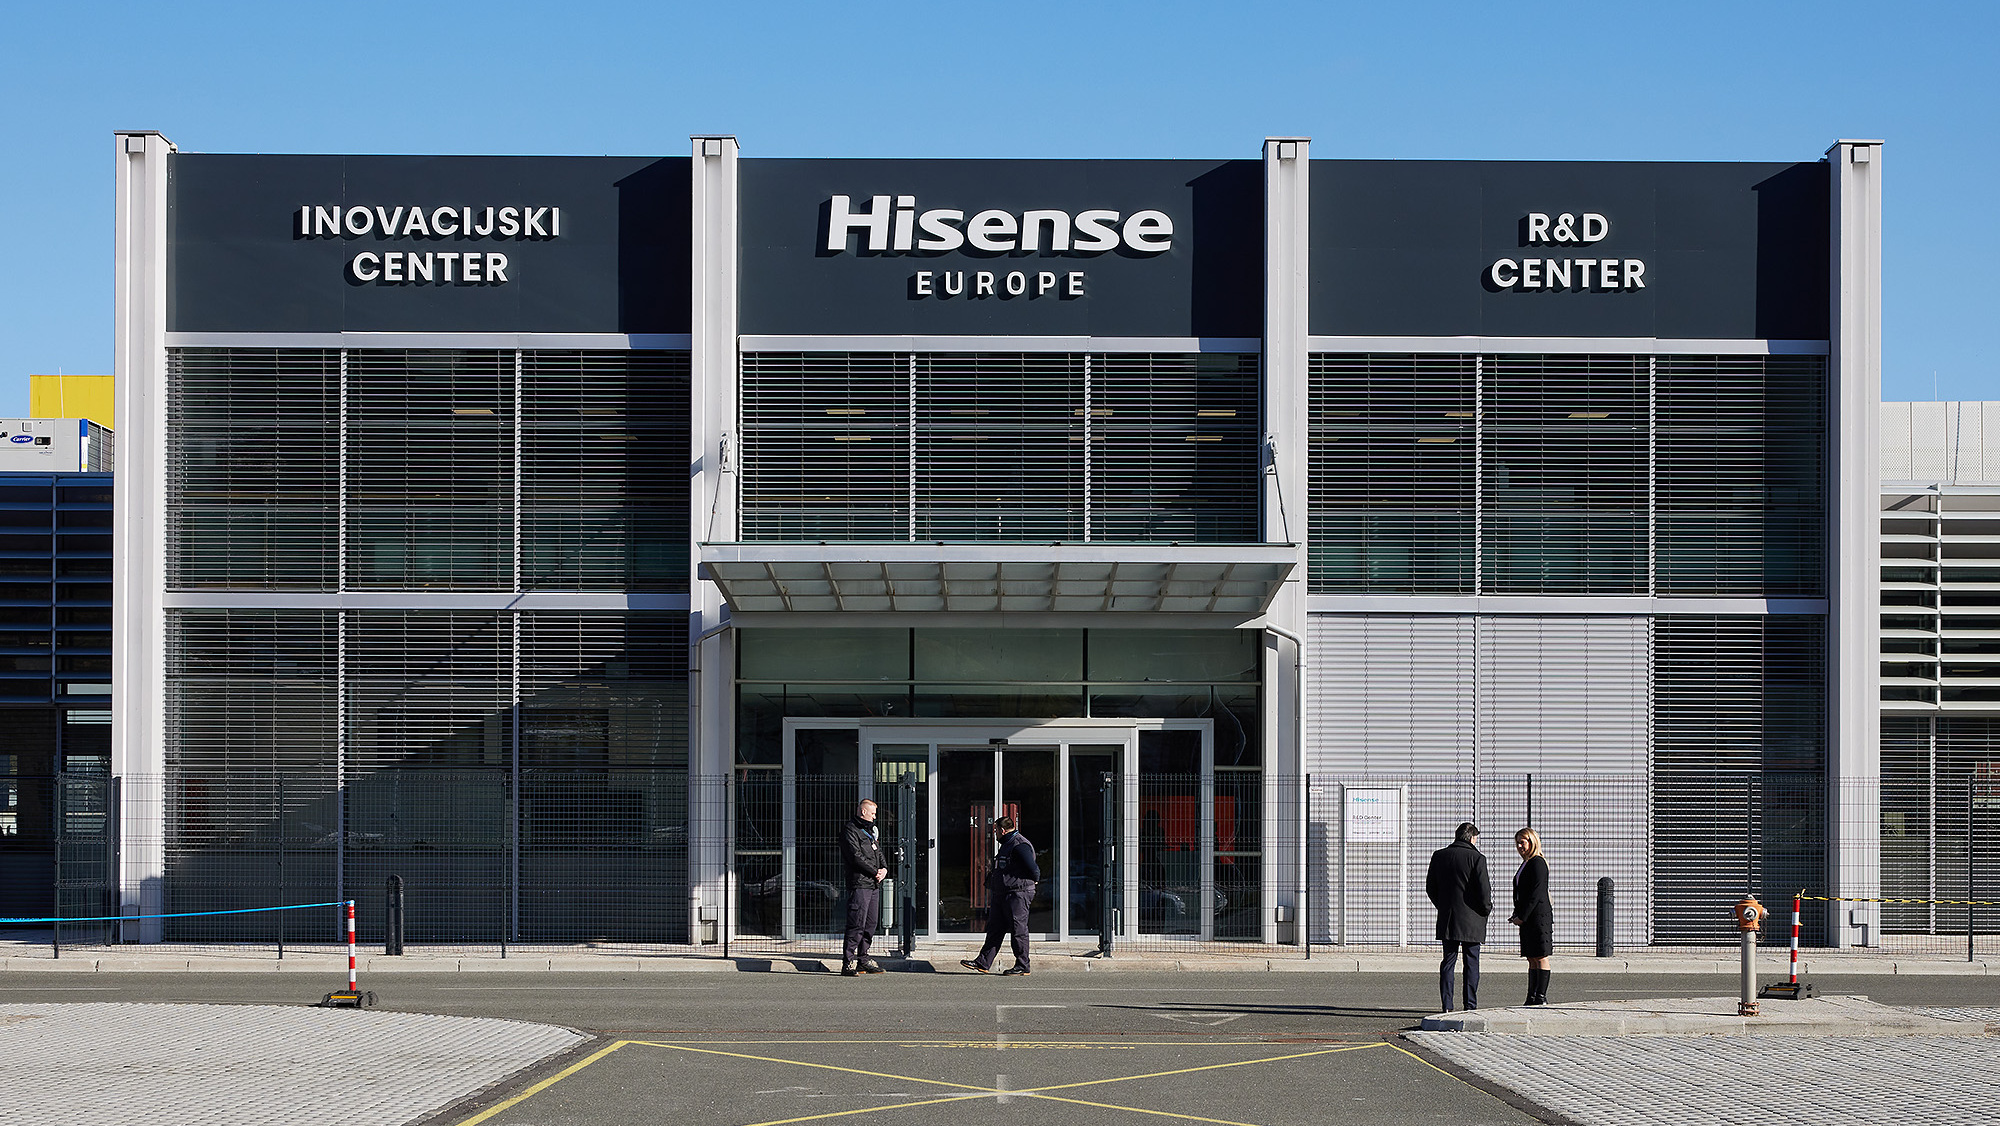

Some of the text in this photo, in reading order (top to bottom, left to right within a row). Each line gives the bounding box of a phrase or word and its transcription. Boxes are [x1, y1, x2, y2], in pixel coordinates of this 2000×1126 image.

[301, 205, 560, 236] INOVACIJSKI
[827, 195, 1174, 252] Hisense
[1528, 212, 1609, 242] R&D
[352, 251, 509, 282] CENTER
[1491, 258, 1646, 288] CENTER
[916, 271, 1085, 296] EUROPE
